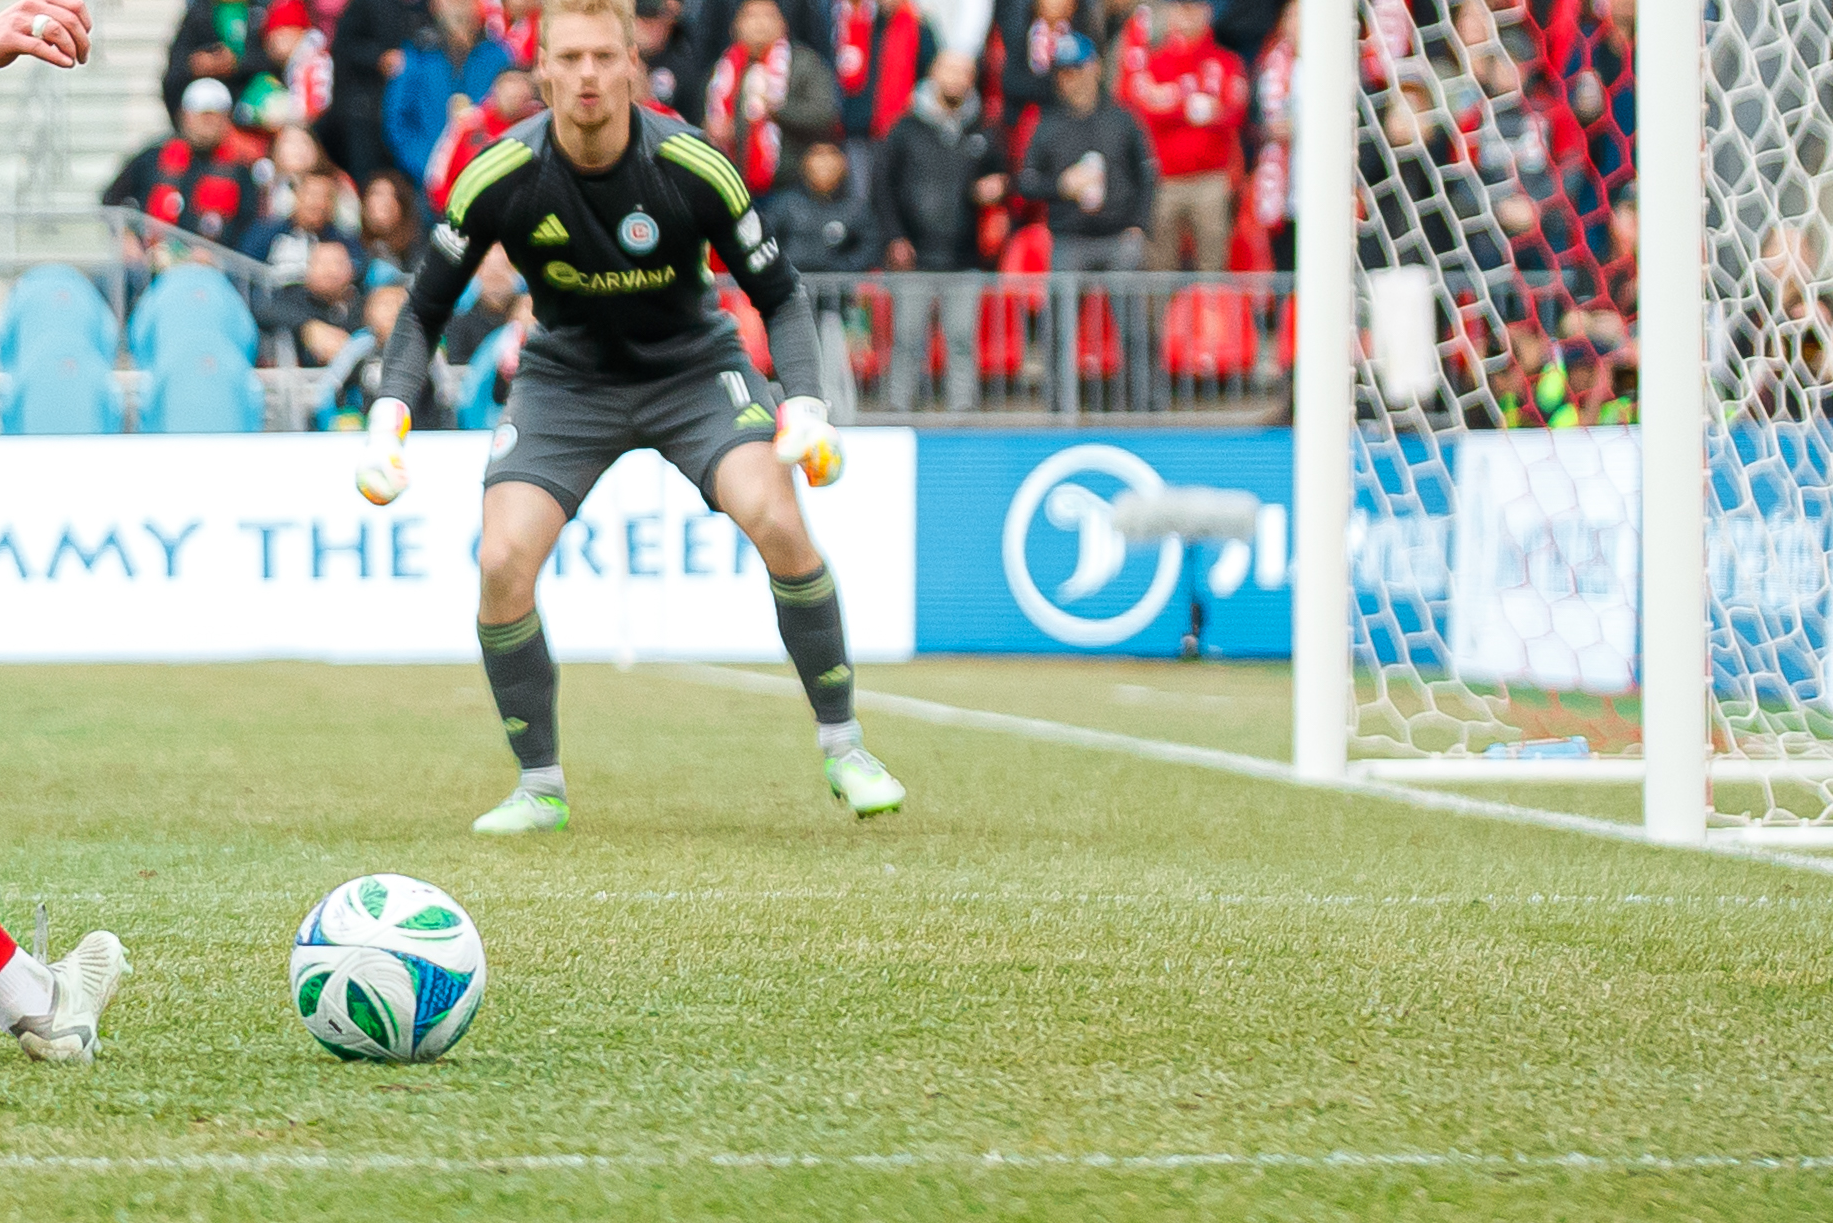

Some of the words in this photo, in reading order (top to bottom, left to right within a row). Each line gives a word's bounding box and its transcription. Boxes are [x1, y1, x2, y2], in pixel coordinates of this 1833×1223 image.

[579, 265, 676, 292] CARVANA
[238, 516, 426, 581] THE
[471, 513, 755, 578] REE
